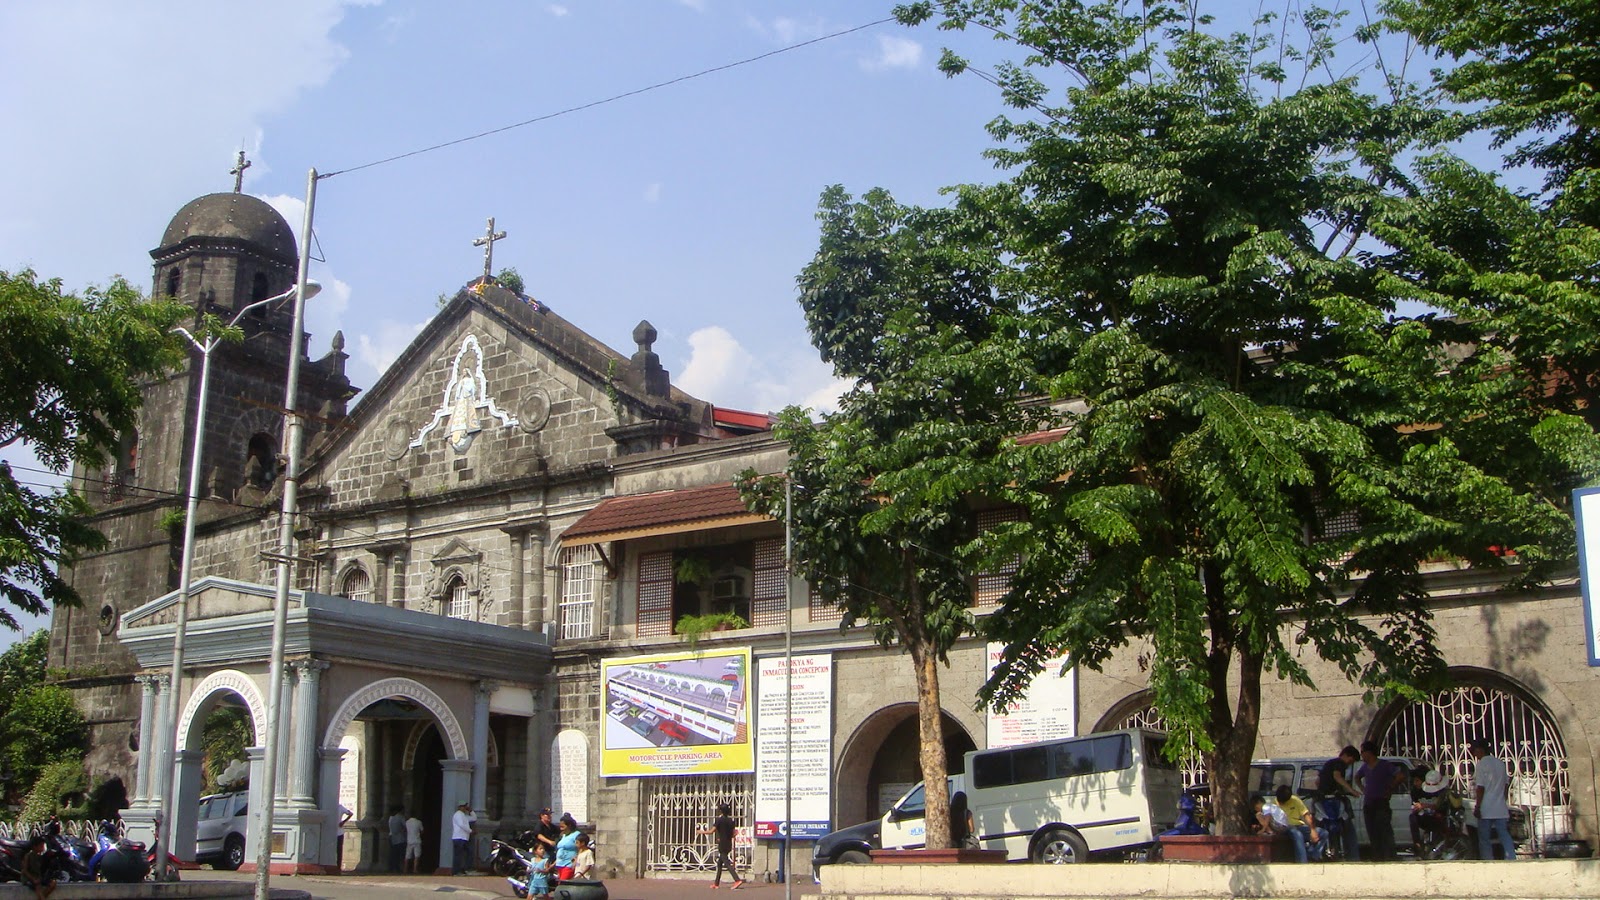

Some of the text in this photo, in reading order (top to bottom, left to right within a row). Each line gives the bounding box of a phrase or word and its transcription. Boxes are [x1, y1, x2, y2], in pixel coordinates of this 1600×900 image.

[778, 659, 805, 667] PAOKYA
[762, 666, 829, 676] INMACULDA CONCEPCION
[629, 754, 673, 762] MOTORCYCLE
[674, 753, 703, 761] PARKING
